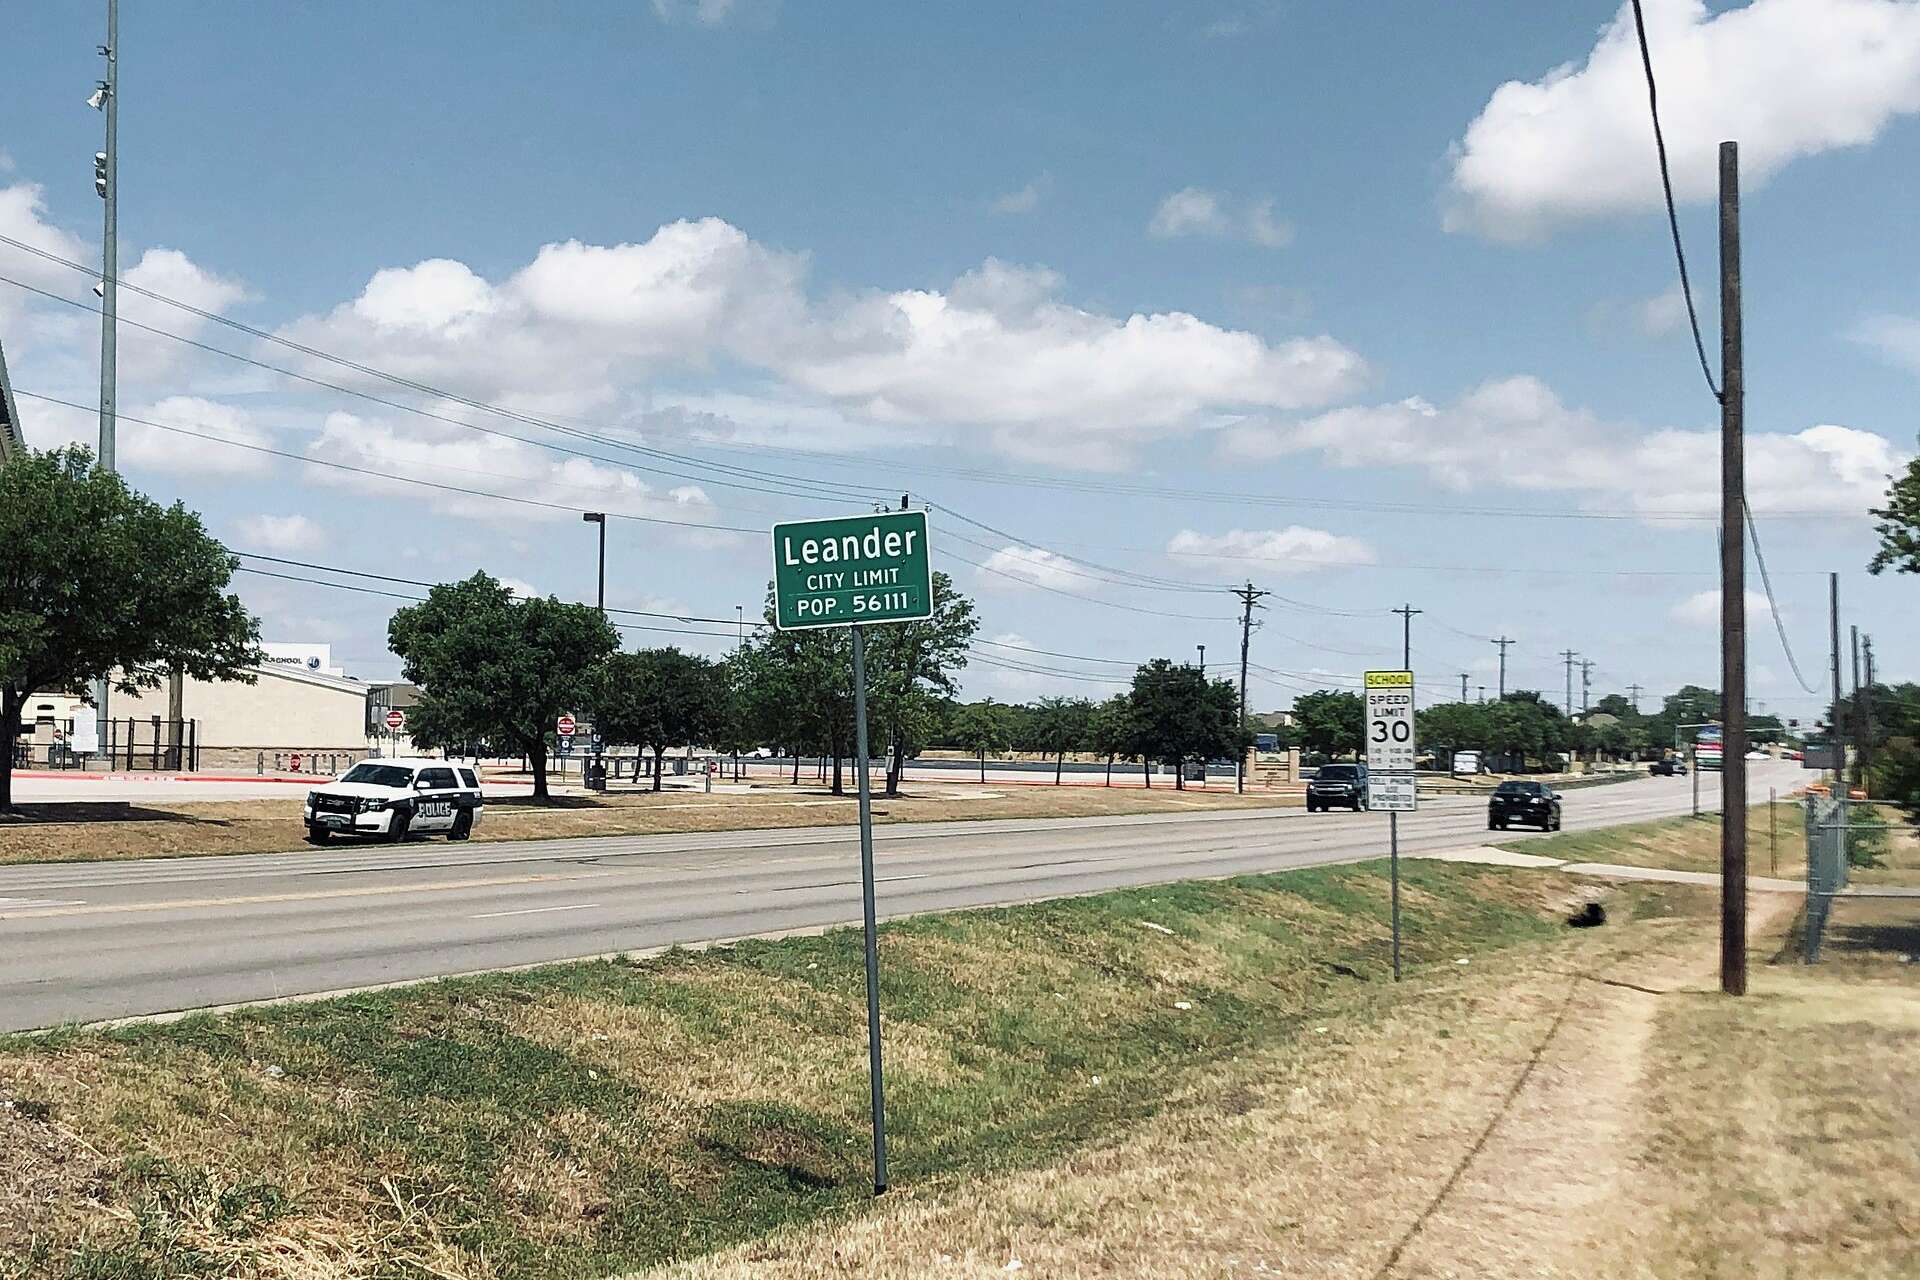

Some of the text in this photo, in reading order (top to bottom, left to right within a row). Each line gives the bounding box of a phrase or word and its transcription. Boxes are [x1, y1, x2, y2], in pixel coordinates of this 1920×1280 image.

[784, 527, 917, 566] Leander
[806, 568, 899, 590] CITY LIMIT
[797, 592, 908, 616] POP. 56111
[1368, 674, 1411, 685] SCHOOL
[1369, 695, 1410, 704] SPEED
[1373, 707, 1406, 718] LIMIT
[1371, 720, 1410, 743] 30
[418, 802, 451, 817] POLICE
